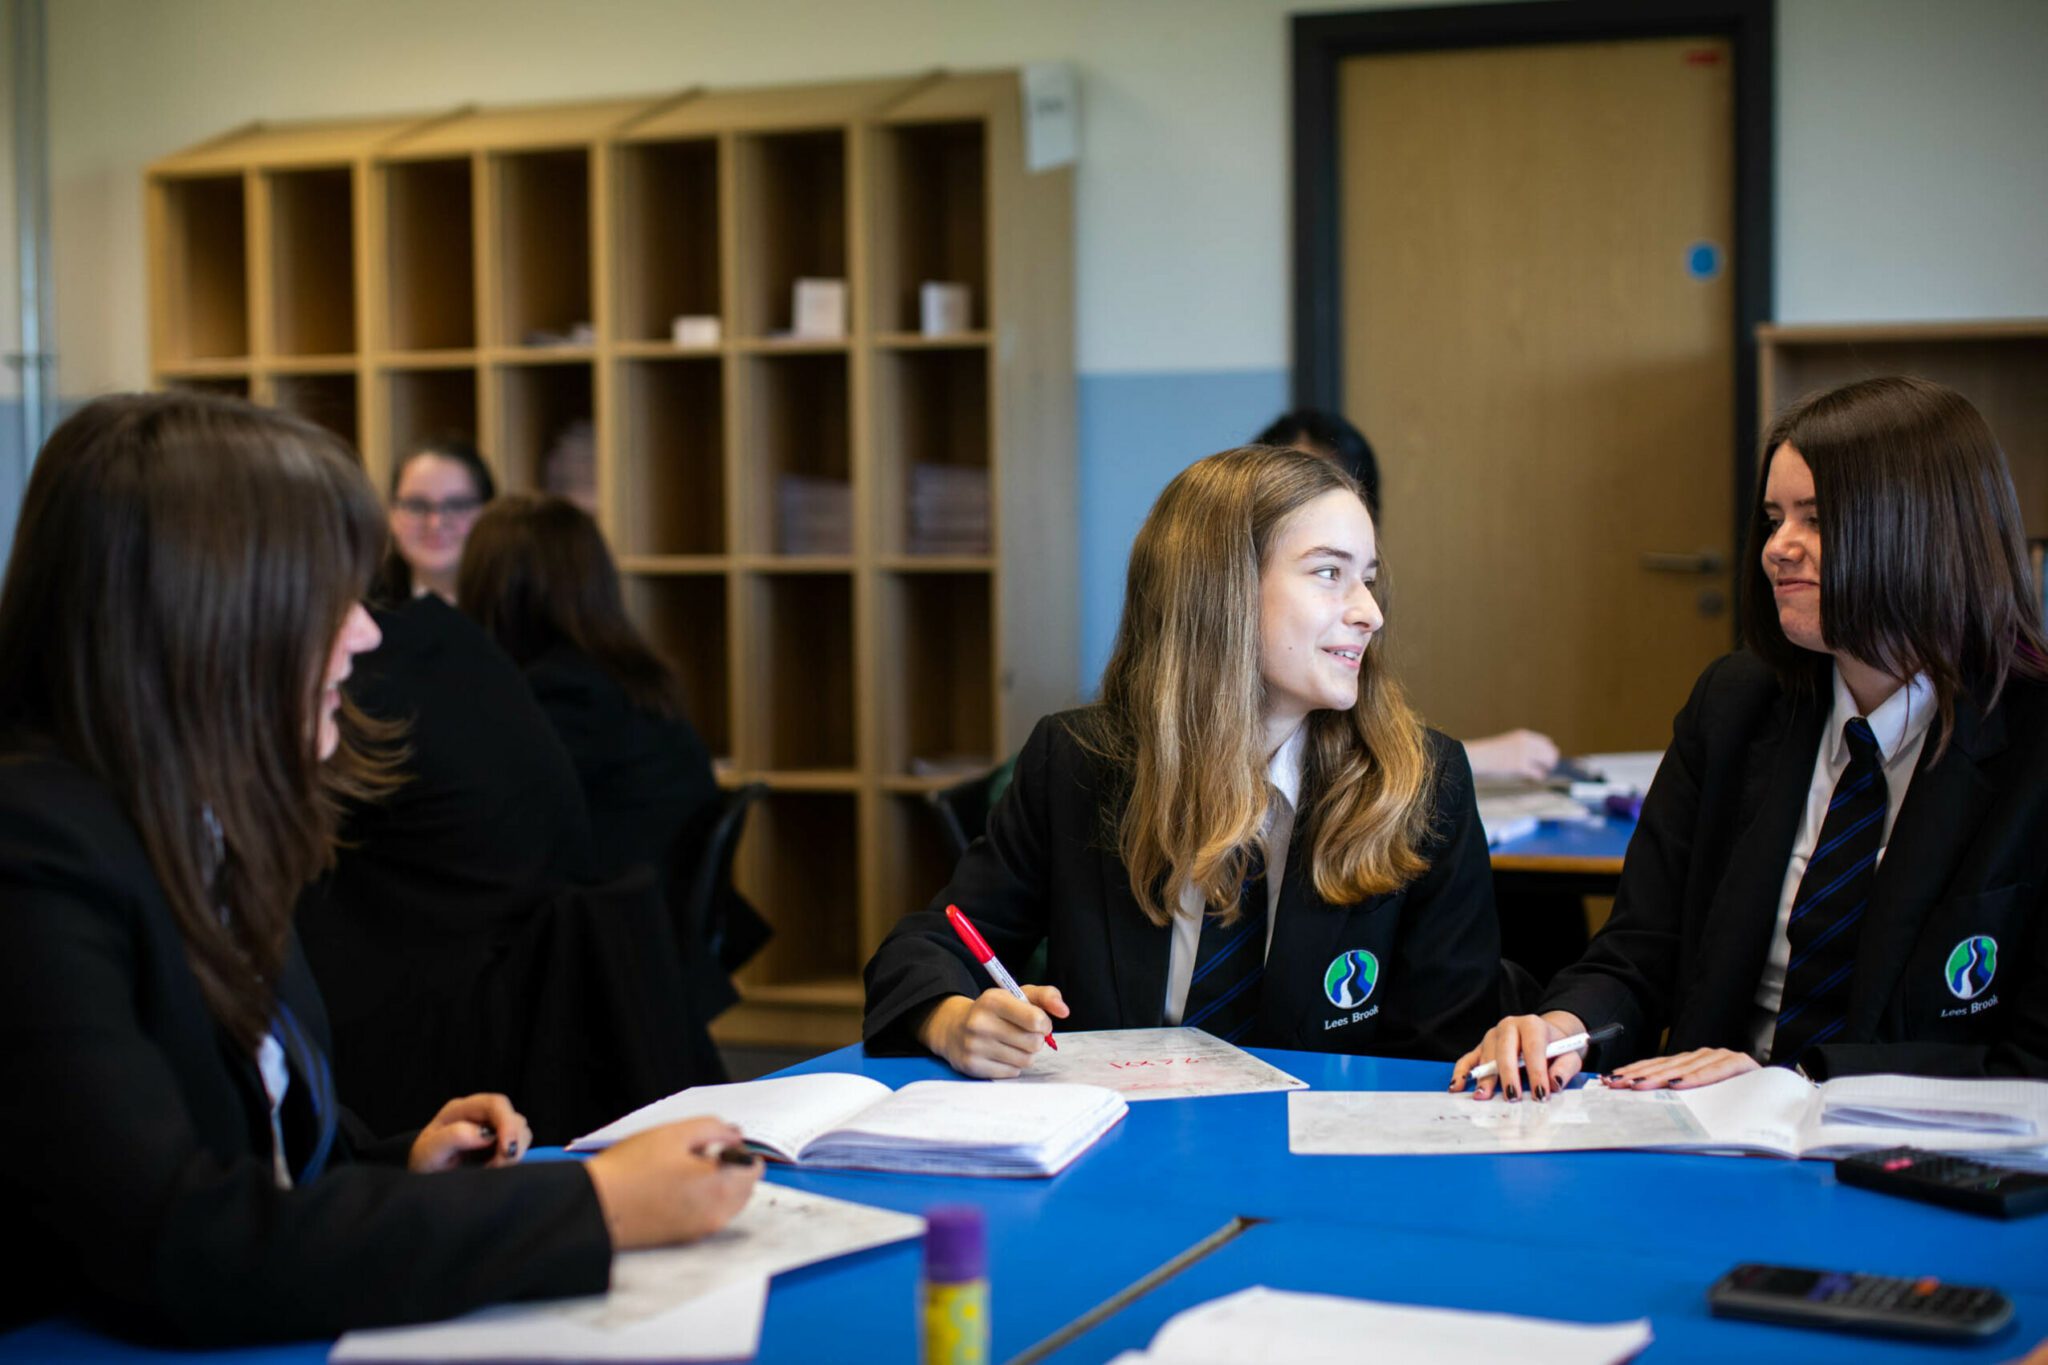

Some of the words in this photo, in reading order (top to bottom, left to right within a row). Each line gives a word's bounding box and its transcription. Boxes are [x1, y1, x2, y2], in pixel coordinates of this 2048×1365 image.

[1324, 1017, 1349, 1030] Lees
[1352, 1005, 1379, 1023] Brook
[1940, 1008, 1967, 1018] Lees
[1970, 994, 1999, 1014] Brook
